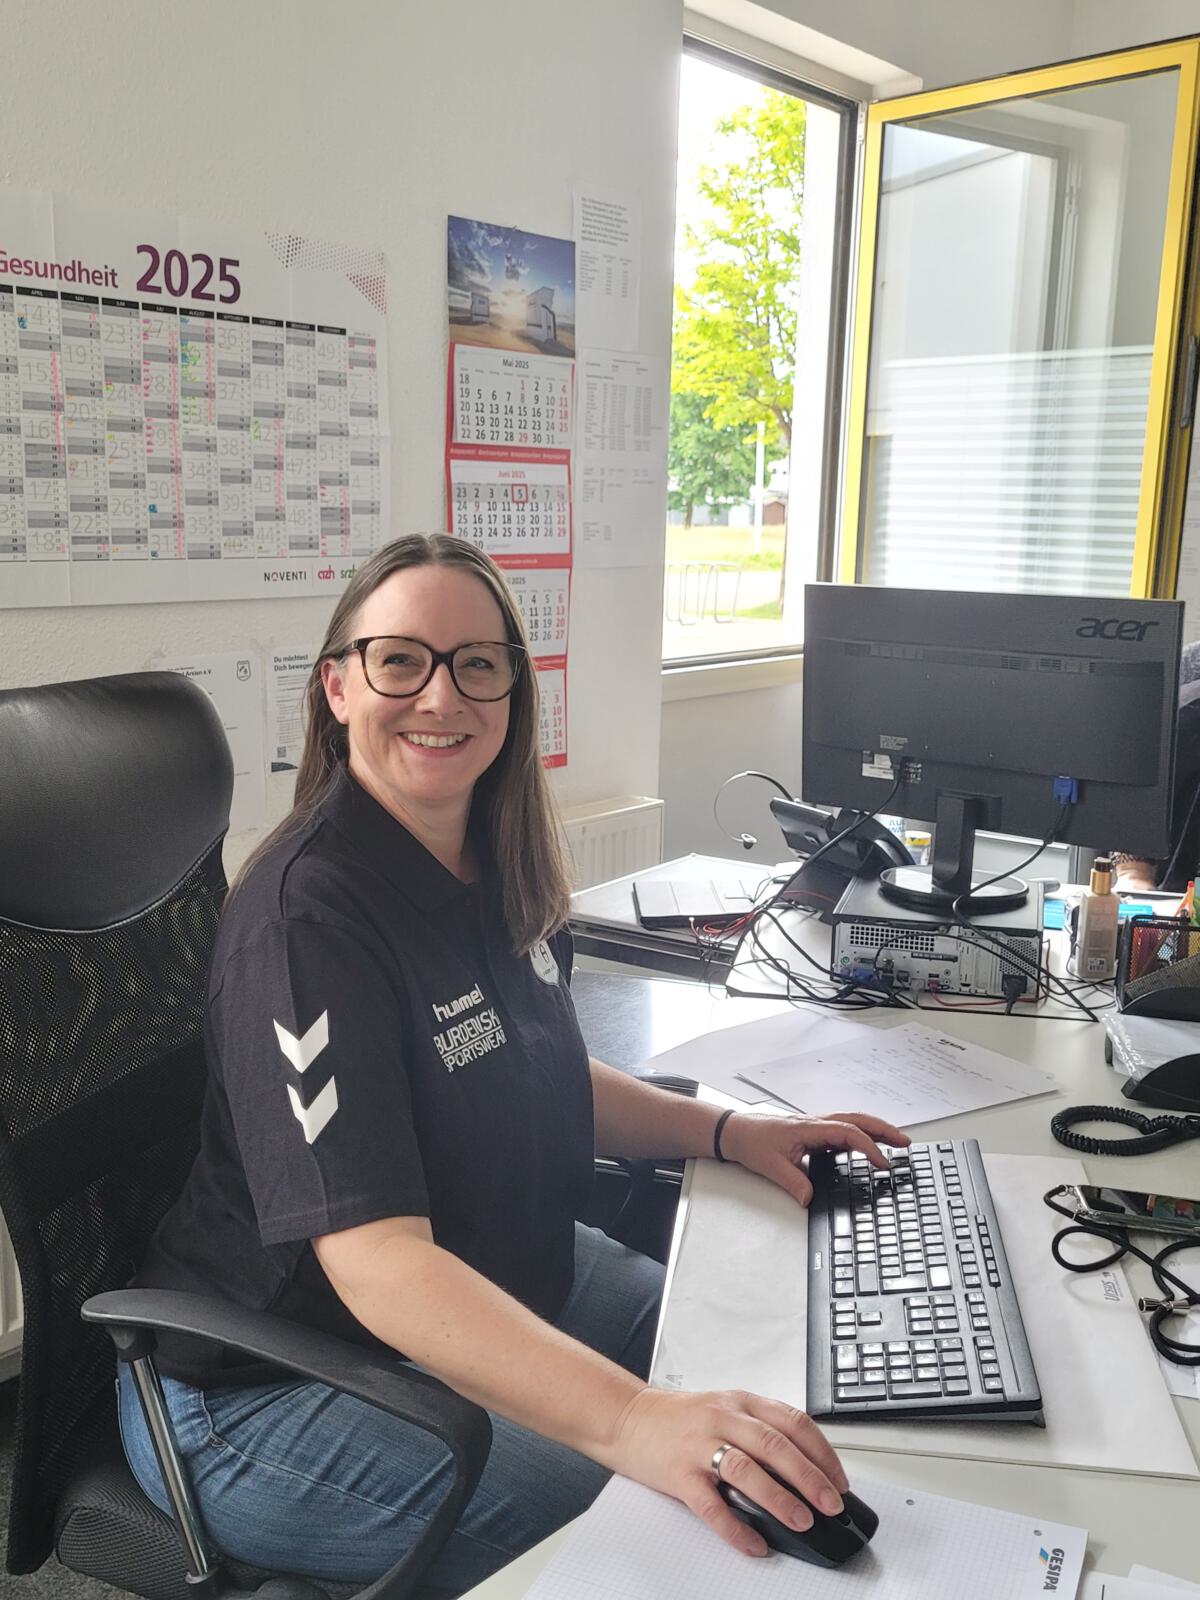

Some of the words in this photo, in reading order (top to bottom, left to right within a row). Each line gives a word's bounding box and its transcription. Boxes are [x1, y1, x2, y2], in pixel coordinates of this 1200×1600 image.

[136, 244, 241, 304] 2025
[502, 359, 514, 367] Mai
[515, 360, 529, 369] 2025
[460, 374, 470, 384] 18
[520, 380, 525, 390] 1
[534, 381, 539, 392] 2
[548, 382, 553, 392] 3
[561, 385, 567, 394] 4
[460, 387, 470, 398] 19
[477, 389, 482, 399] 5
[492, 390, 497, 401] 6
[506, 392, 511, 402] 7
[520, 393, 525, 403] 8
[534, 394, 539, 404] 9
[546, 396, 555, 406] 10
[560, 397, 568, 407] 11
[460, 401, 470, 412] 20
[475, 402, 484, 413] 12
[489, 404, 499, 414] 13
[504, 405, 514, 415] 14
[518, 406, 527, 416] 15
[532, 407, 541, 418] 16
[546, 409, 555, 419] 17
[560, 410, 568, 420] 18
[461, 415, 470, 426] 21
[475, 416, 485, 426] 19
[490, 417, 500, 428] 20
[504, 418, 514, 429] 21
[518, 419, 528, 430] 22
[532, 421, 541, 431] 23
[546, 422, 555, 432] 24
[560, 423, 568, 432] 25
[461, 428, 471, 439] 22
[475, 429, 486, 440] 26
[490, 430, 500, 441] 27
[504, 432, 514, 442] 28
[518, 433, 528, 443] 29
[532, 434, 542, 444] 30
[546, 435, 555, 445] 31
[511, 471, 526, 479] 2025
[456, 488, 467, 498] 23
[475, 488, 479, 498] 2
[489, 488, 494, 498] 3
[504, 489, 508, 498] 4
[518, 489, 523, 499] 5
[532, 489, 536, 499] 6
[545, 490, 550, 499] 7
[457, 501, 467, 511] 24
[474, 502, 480, 512] 9
[487, 502, 497, 512] 10
[502, 502, 511, 512] 11
[516, 502, 525, 512] 12
[530, 502, 539, 512] 13
[543, 502, 552, 512] 14
[557, 502, 566, 512] 15
[457, 514, 468, 524] 25
[473, 514, 483, 524] 16
[488, 515, 498, 524] 17
[502, 515, 512, 524] 18
[516, 515, 526, 524] 19
[530, 515, 540, 525] 20
[544, 515, 553, 525] 21
[557, 515, 566, 525] 22
[458, 528, 468, 537] 26
[473, 528, 483, 537] 23
[488, 528, 498, 537] 24
[502, 528, 512, 537] 25
[516, 528, 526, 537] 26
[530, 528, 540, 537] 27
[544, 528, 553, 537] 28
[557, 528, 566, 537] 29
[264, 571, 307, 582] NOVENTI
[512, 576, 526, 584] 2025
[531, 594, 536, 604] 4
[545, 594, 550, 603] 5
[558, 594, 563, 603] 6
[520, 608, 525, 616] 0
[529, 608, 538, 616] 11
[543, 606, 552, 616] 12
[530, 620, 538, 629] 18
[543, 619, 552, 628] 19
[556, 618, 565, 628] 20
[530, 632, 538, 641] 25
[543, 631, 551, 640] 26
[556, 630, 564, 640] 27
[1076, 618, 1160, 642] acer
[553, 705, 562, 716] 10
[553, 718, 562, 727] 17
[553, 730, 562, 739] 24
[432, 983, 485, 1022] hummel
[1043, 1548, 1065, 1590] GESIPA
